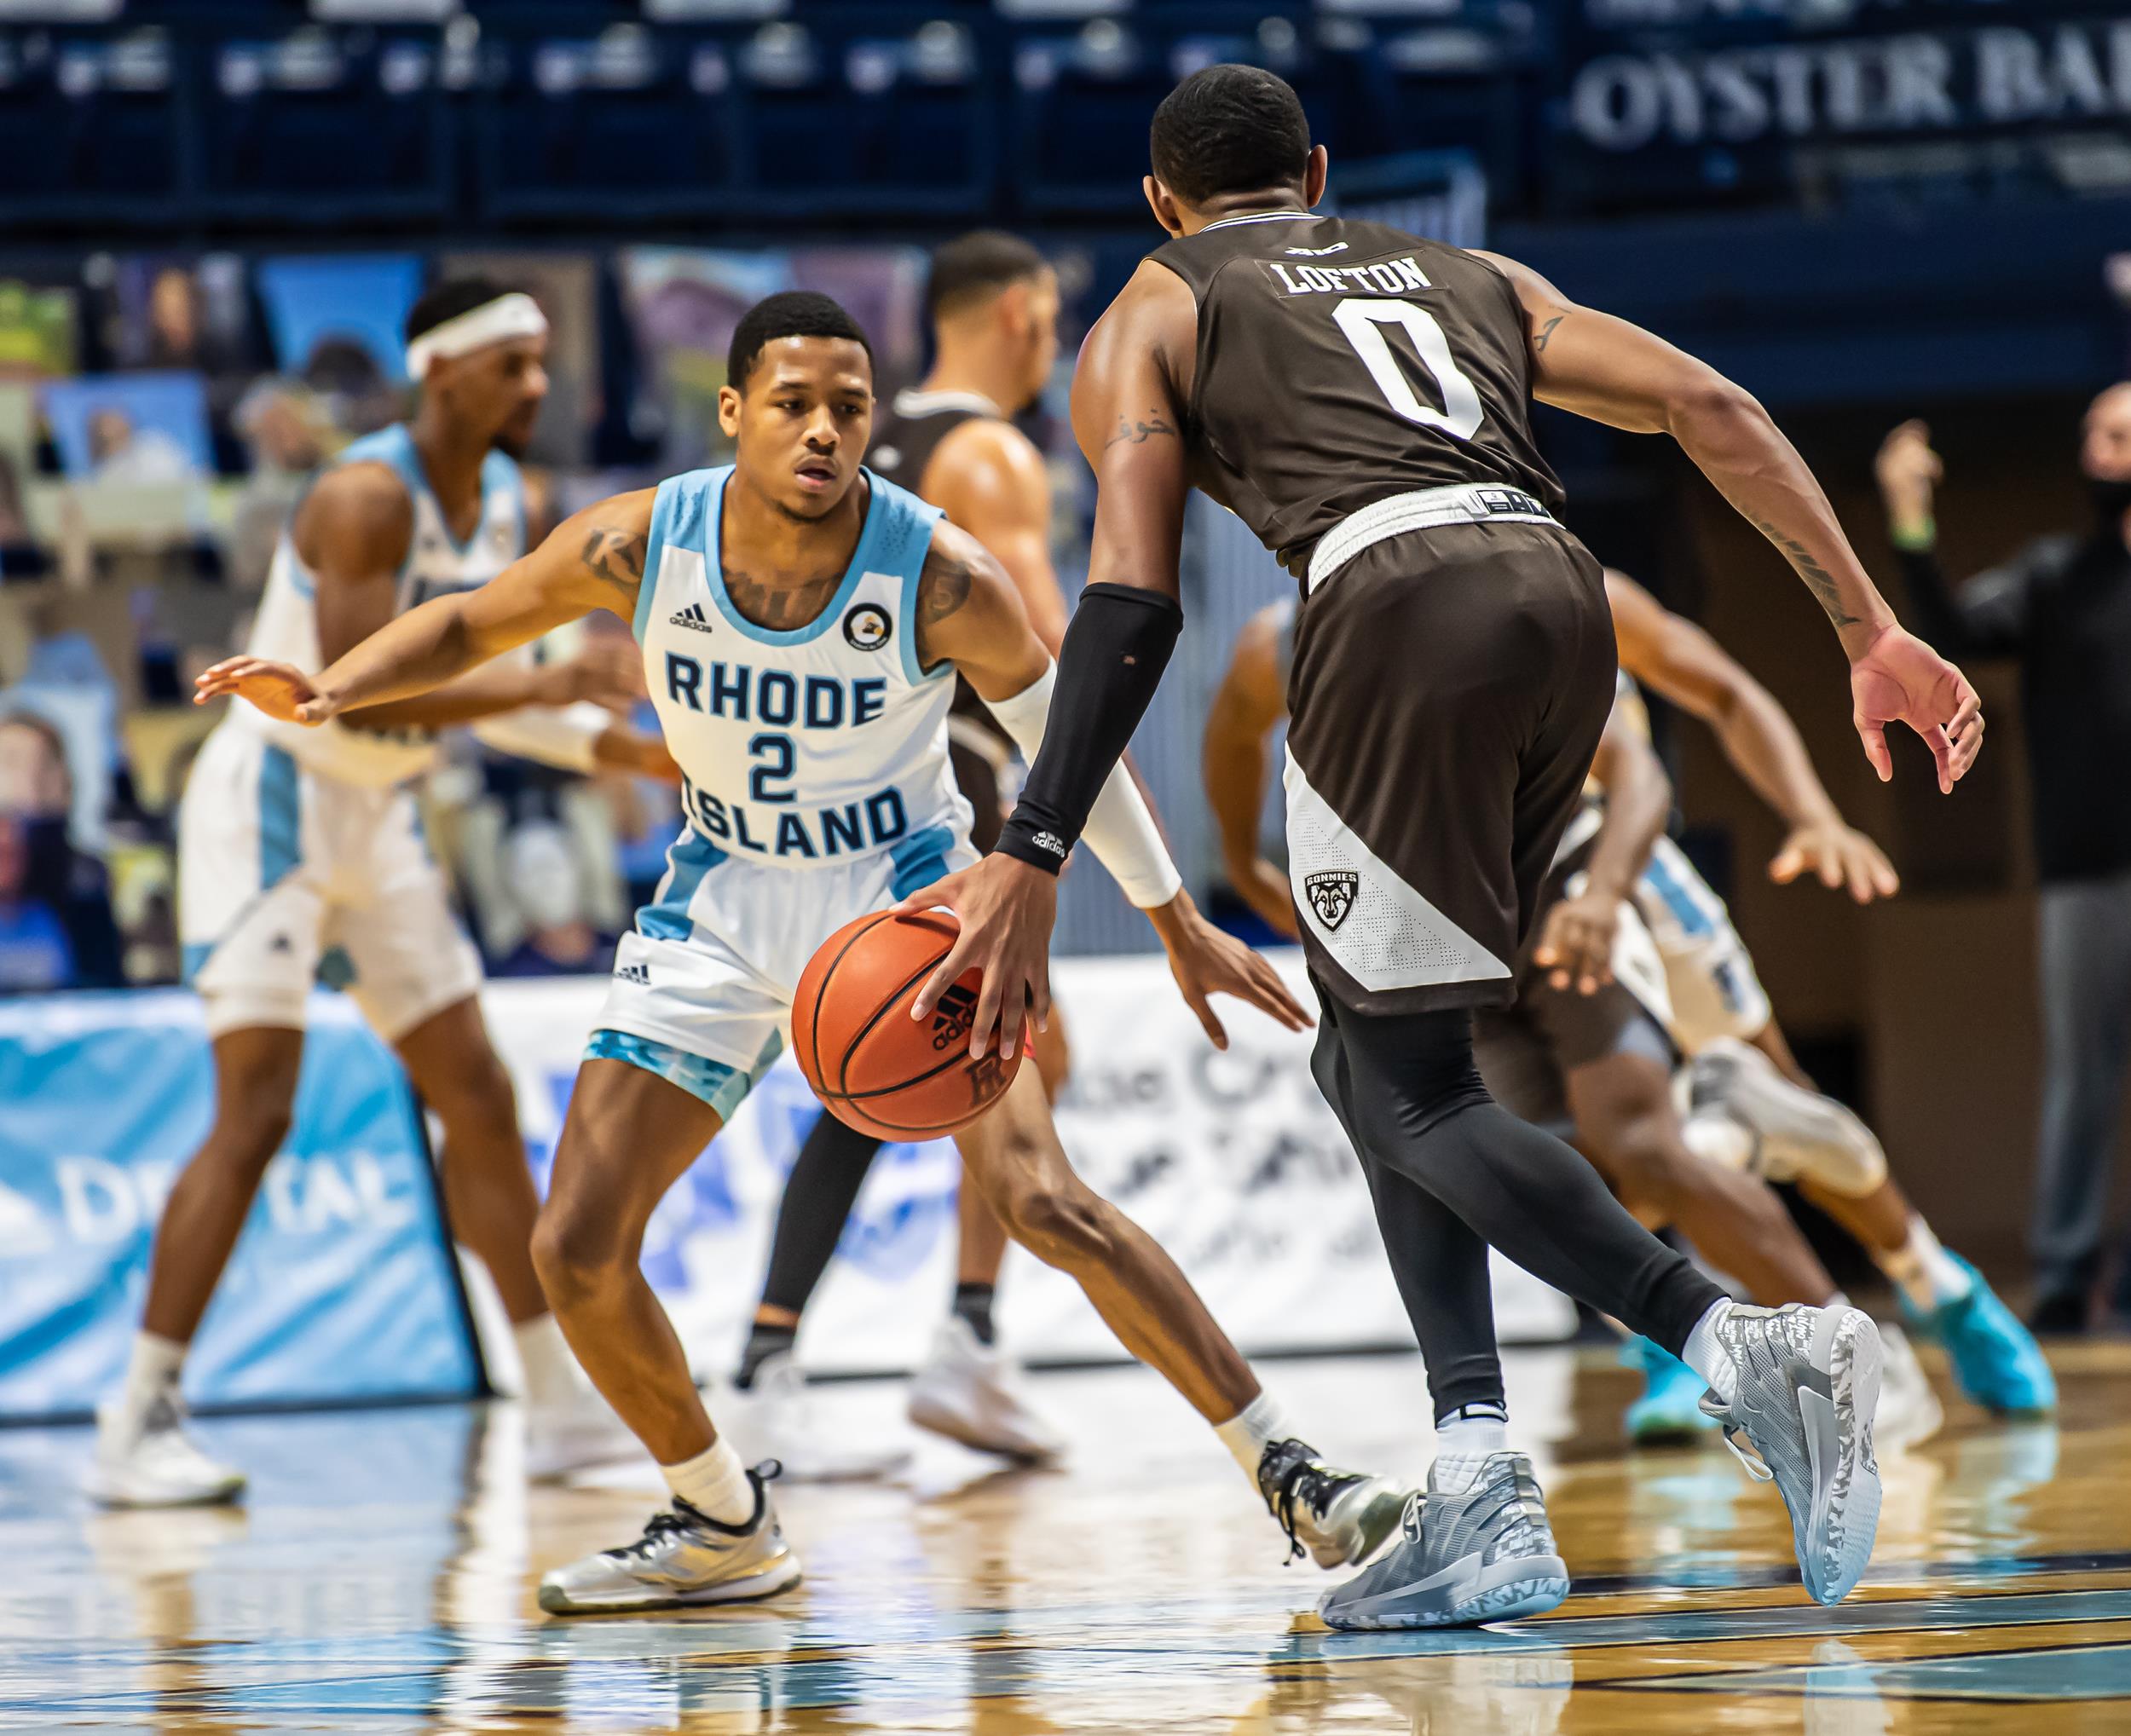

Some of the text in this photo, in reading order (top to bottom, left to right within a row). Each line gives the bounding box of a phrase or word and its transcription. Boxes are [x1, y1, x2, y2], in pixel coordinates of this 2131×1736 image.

[1270, 257, 1433, 295] LOFTON
[1331, 298, 1485, 441] 0
[669, 617, 713, 633] adidas
[665, 650, 887, 730] RHODE
[748, 732, 798, 805] 2
[1031, 835, 1066, 858] adidas
[1306, 872, 1358, 887] BONNIES
